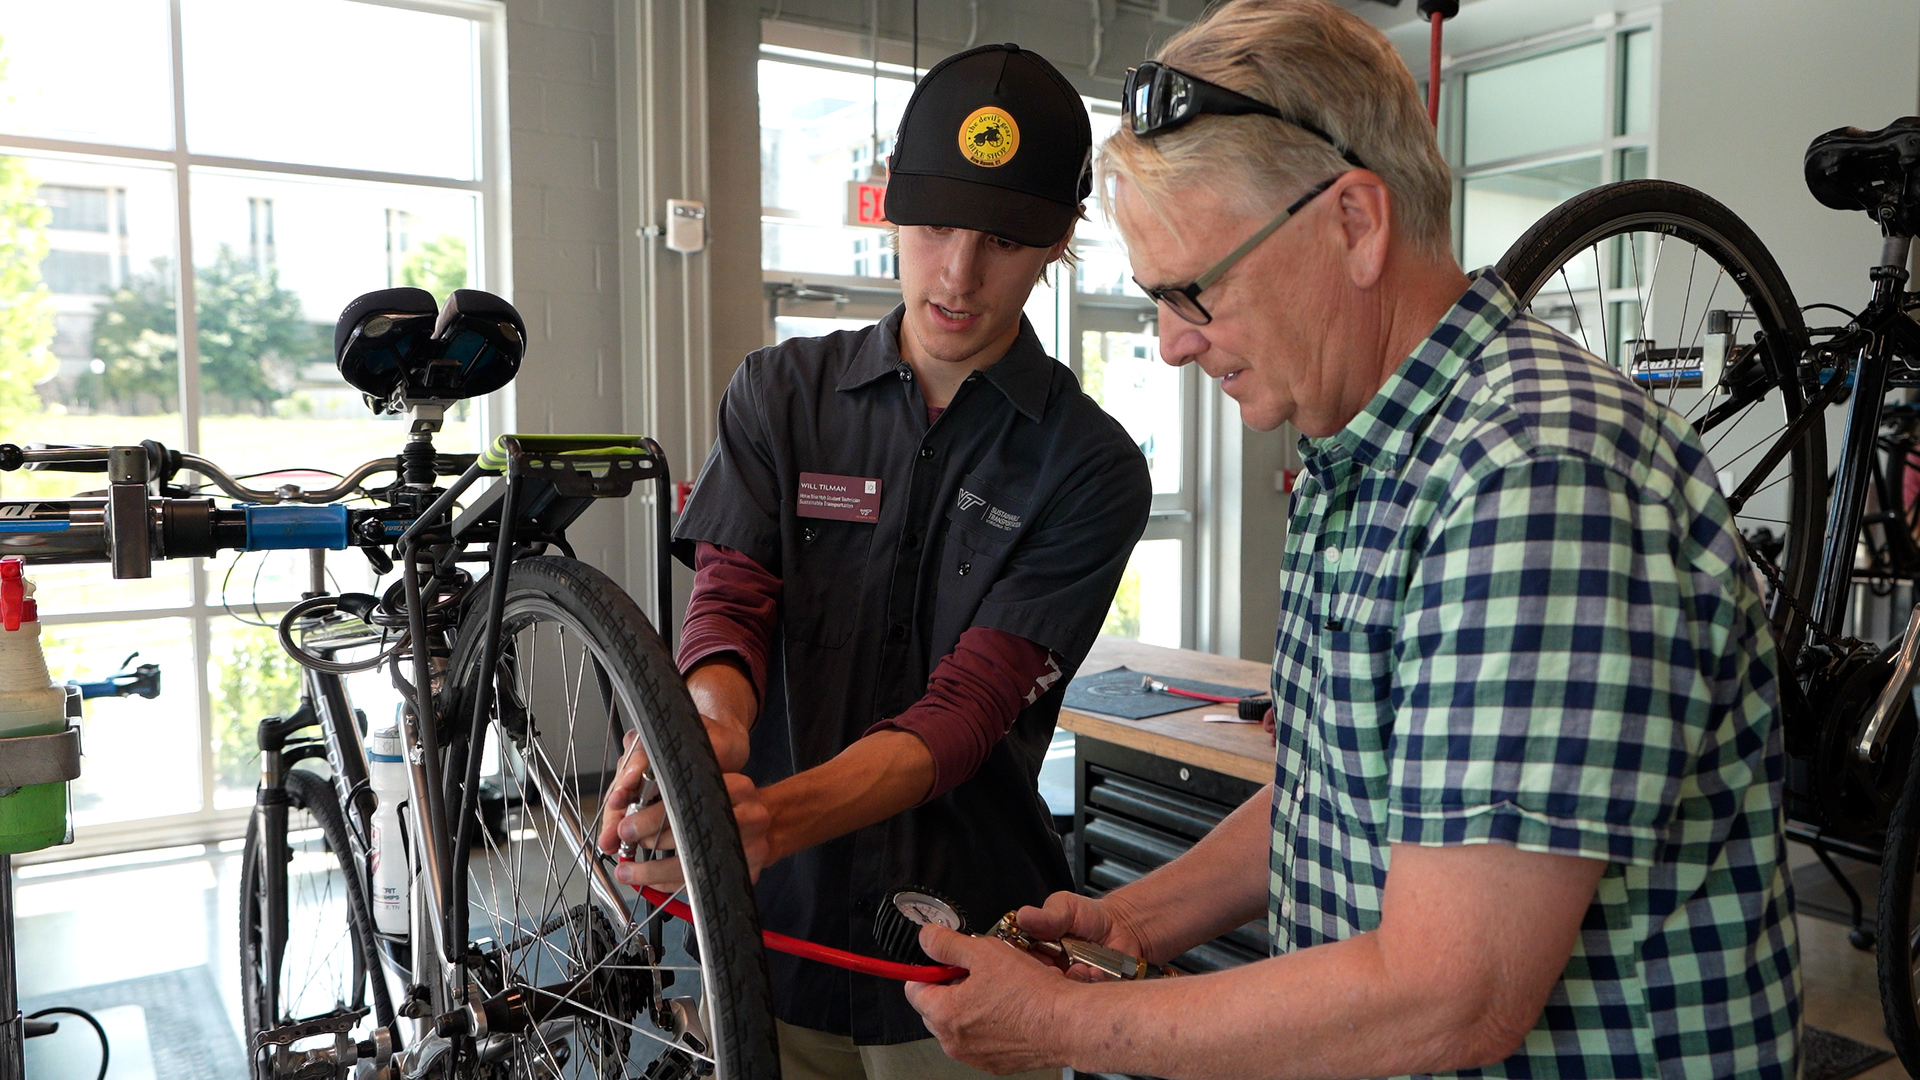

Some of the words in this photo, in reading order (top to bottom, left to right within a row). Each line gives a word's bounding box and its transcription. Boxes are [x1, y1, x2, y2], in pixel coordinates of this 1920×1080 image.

[969, 122, 978, 133] the
[979, 115, 1000, 123] devil's
[1000, 122, 1011, 137] gear
[968, 143, 985, 158] BIKE
[986, 146, 1006, 159] SHOP
[858, 184, 887, 223] EX
[800, 482, 817, 490] WILL
[820, 484, 847, 492] TILMAN
[824, 501, 853, 509] Transportation
